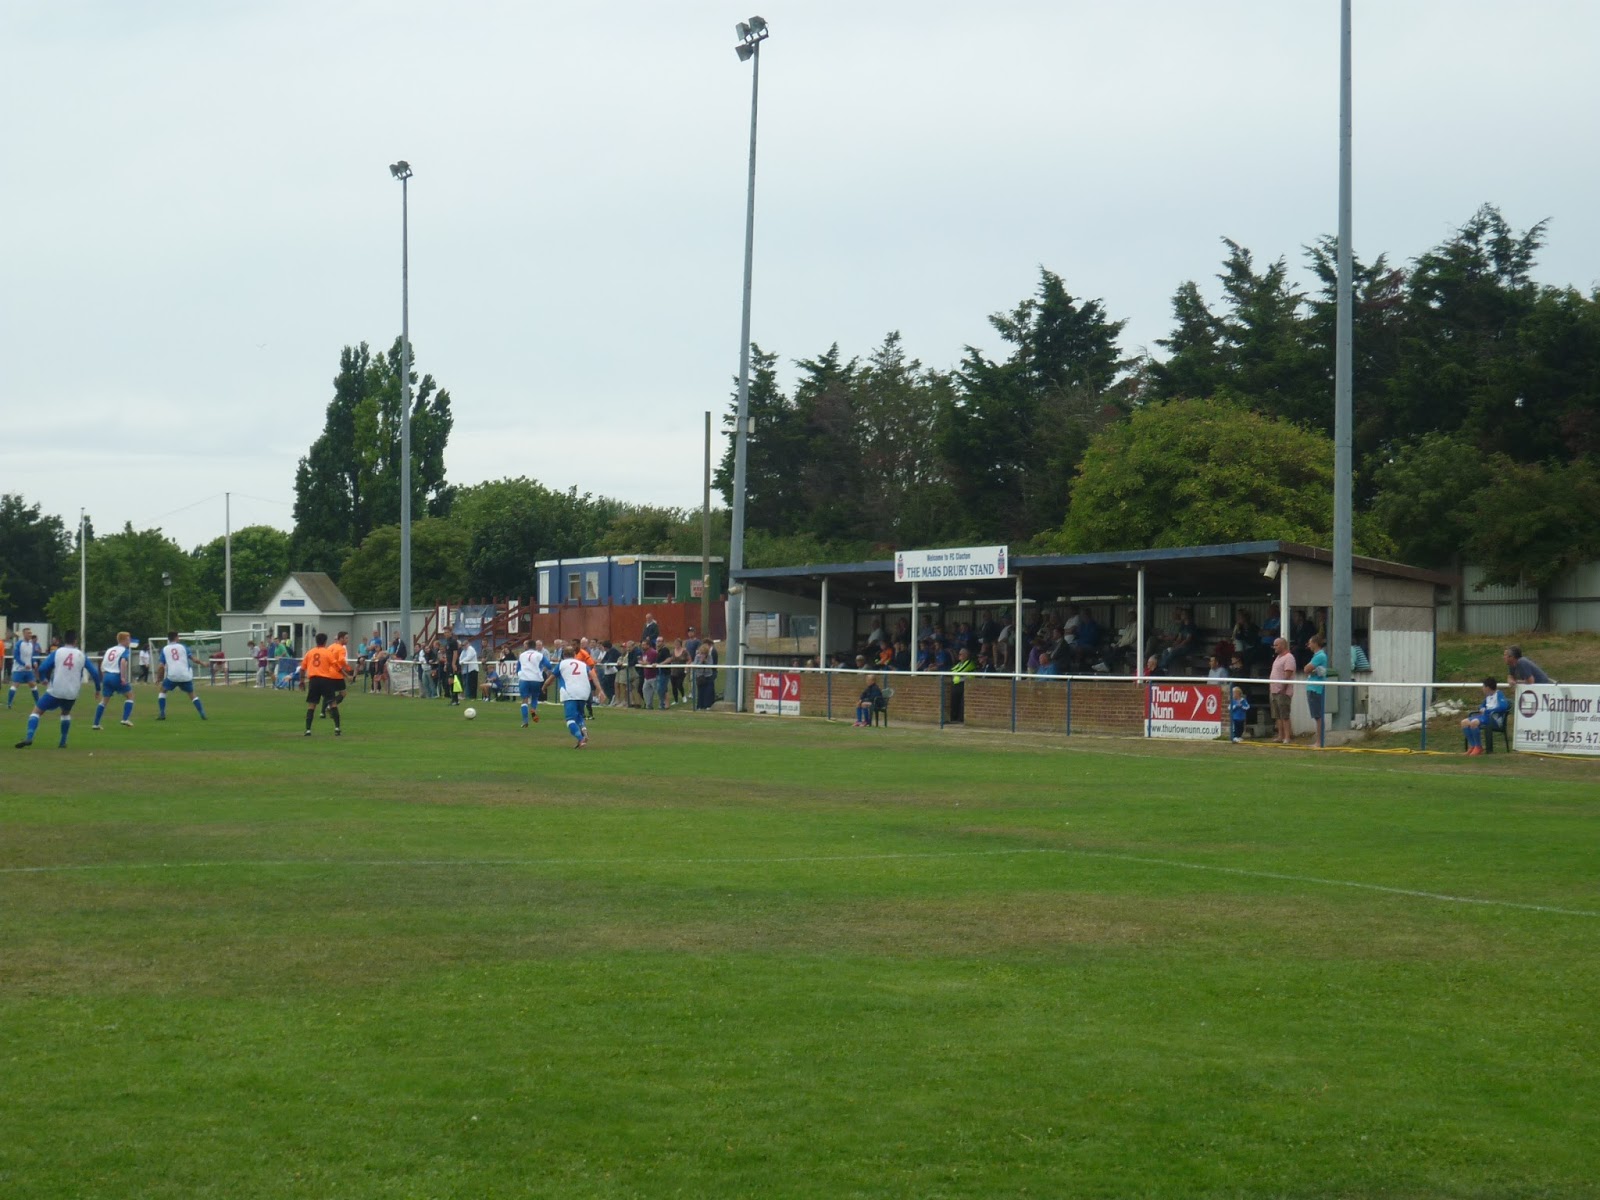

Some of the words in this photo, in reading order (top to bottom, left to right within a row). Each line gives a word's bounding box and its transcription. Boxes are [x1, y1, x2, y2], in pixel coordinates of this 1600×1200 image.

[907, 567, 920, 578] THE
[922, 566, 942, 577] MARS
[943, 564, 969, 576] DRURY
[970, 563, 995, 576] STAND
[107, 649, 117, 662] 6
[171, 648, 179, 660] 8
[312, 653, 321, 667] 8
[526, 652, 534, 661] 7
[63, 653, 74, 670] 4
[498, 663, 508, 675] TO
[570, 662, 580, 675] 2
[758, 686, 772, 699] Nunn
[1151, 686, 1188, 703] Thurlow
[1541, 694, 1592, 713] Nantmor
[1150, 703, 1174, 719] Nunn
[1147, 724, 1219, 735] ww.thurlownunn.co.uk
[1525, 730, 1544, 742] Tel:
[1548, 731, 1582, 743] 01255
